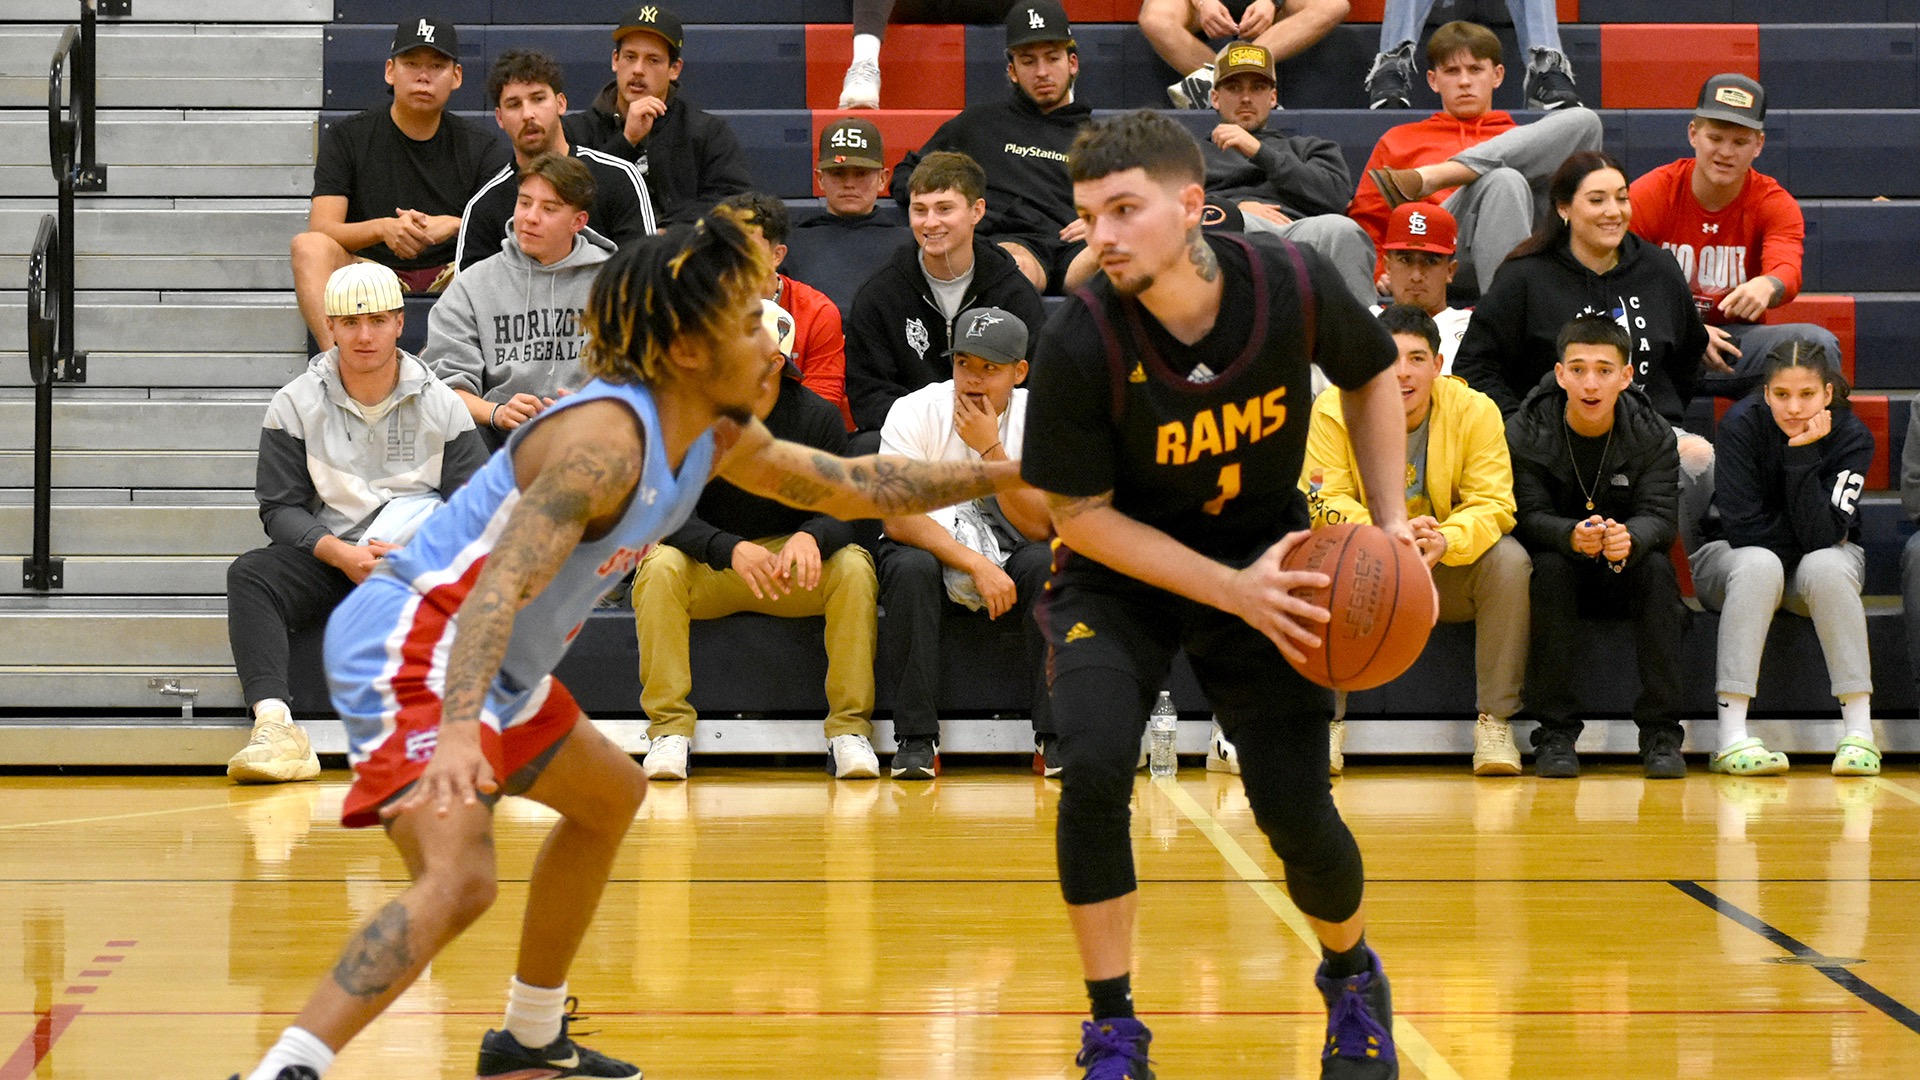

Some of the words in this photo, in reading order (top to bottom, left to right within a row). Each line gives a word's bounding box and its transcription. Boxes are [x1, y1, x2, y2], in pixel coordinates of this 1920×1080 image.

[638, 5, 659, 24] NY
[1027, 8, 1046, 30] LA
[416, 18, 436, 44] AZ
[1003, 142, 1071, 164] PlayStation
[1628, 295, 1651, 393] COAC
[1155, 384, 1288, 466] RAMS
[1830, 468, 1865, 516] 12
